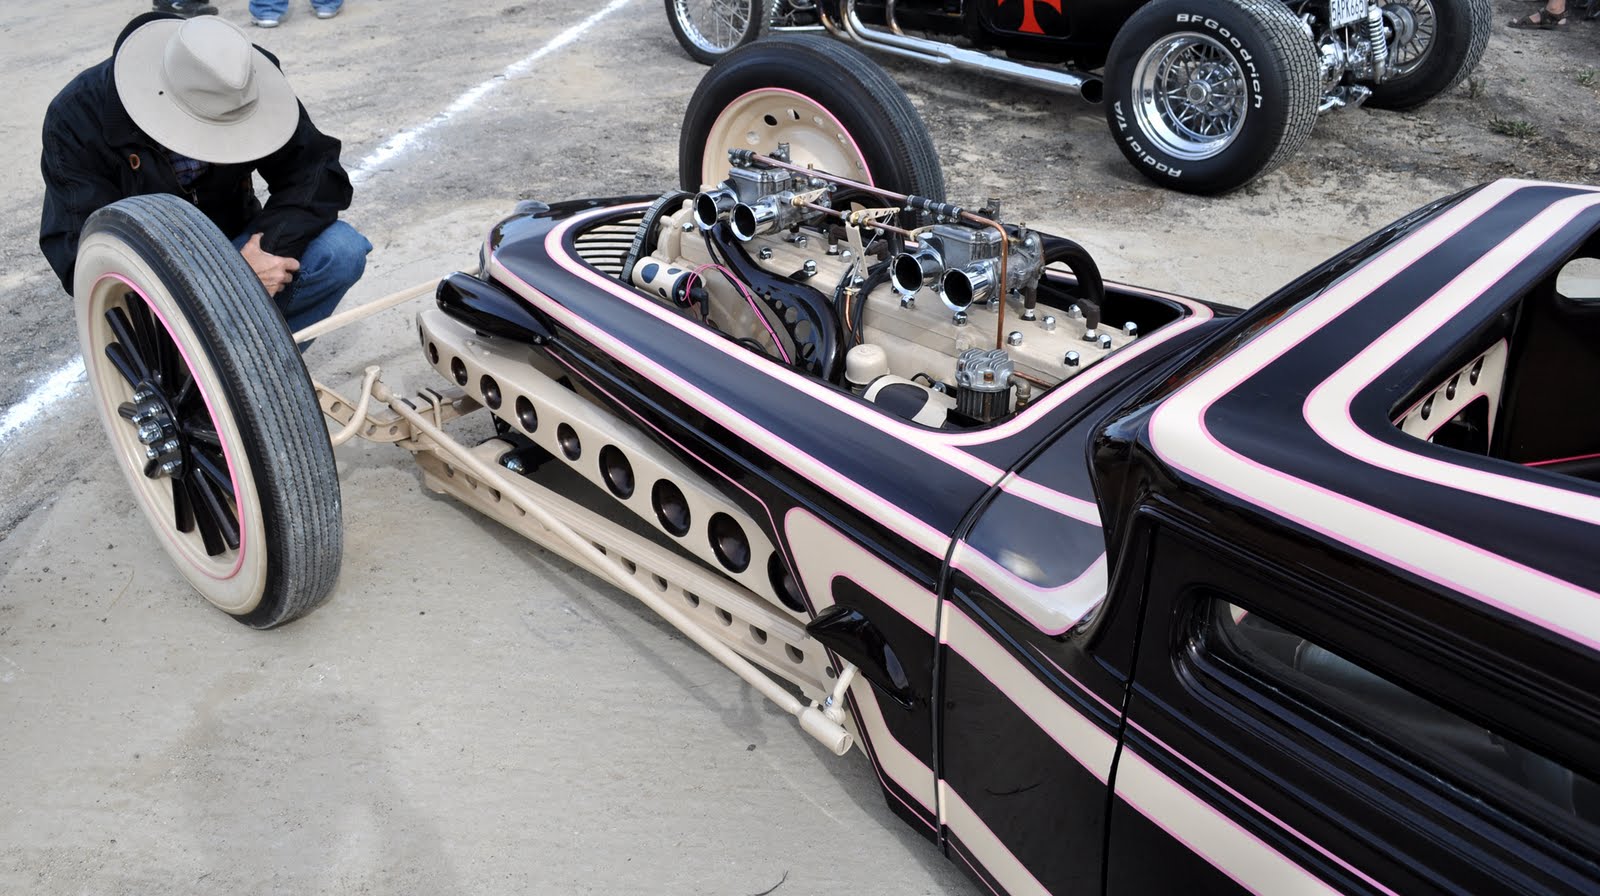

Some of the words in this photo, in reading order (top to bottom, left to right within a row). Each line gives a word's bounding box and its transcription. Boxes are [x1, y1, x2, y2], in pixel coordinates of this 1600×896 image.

[1176, 13, 1263, 109] BFGoodrich
[1113, 100, 1127, 131] T/A
[1126, 136, 1182, 178] Radial
